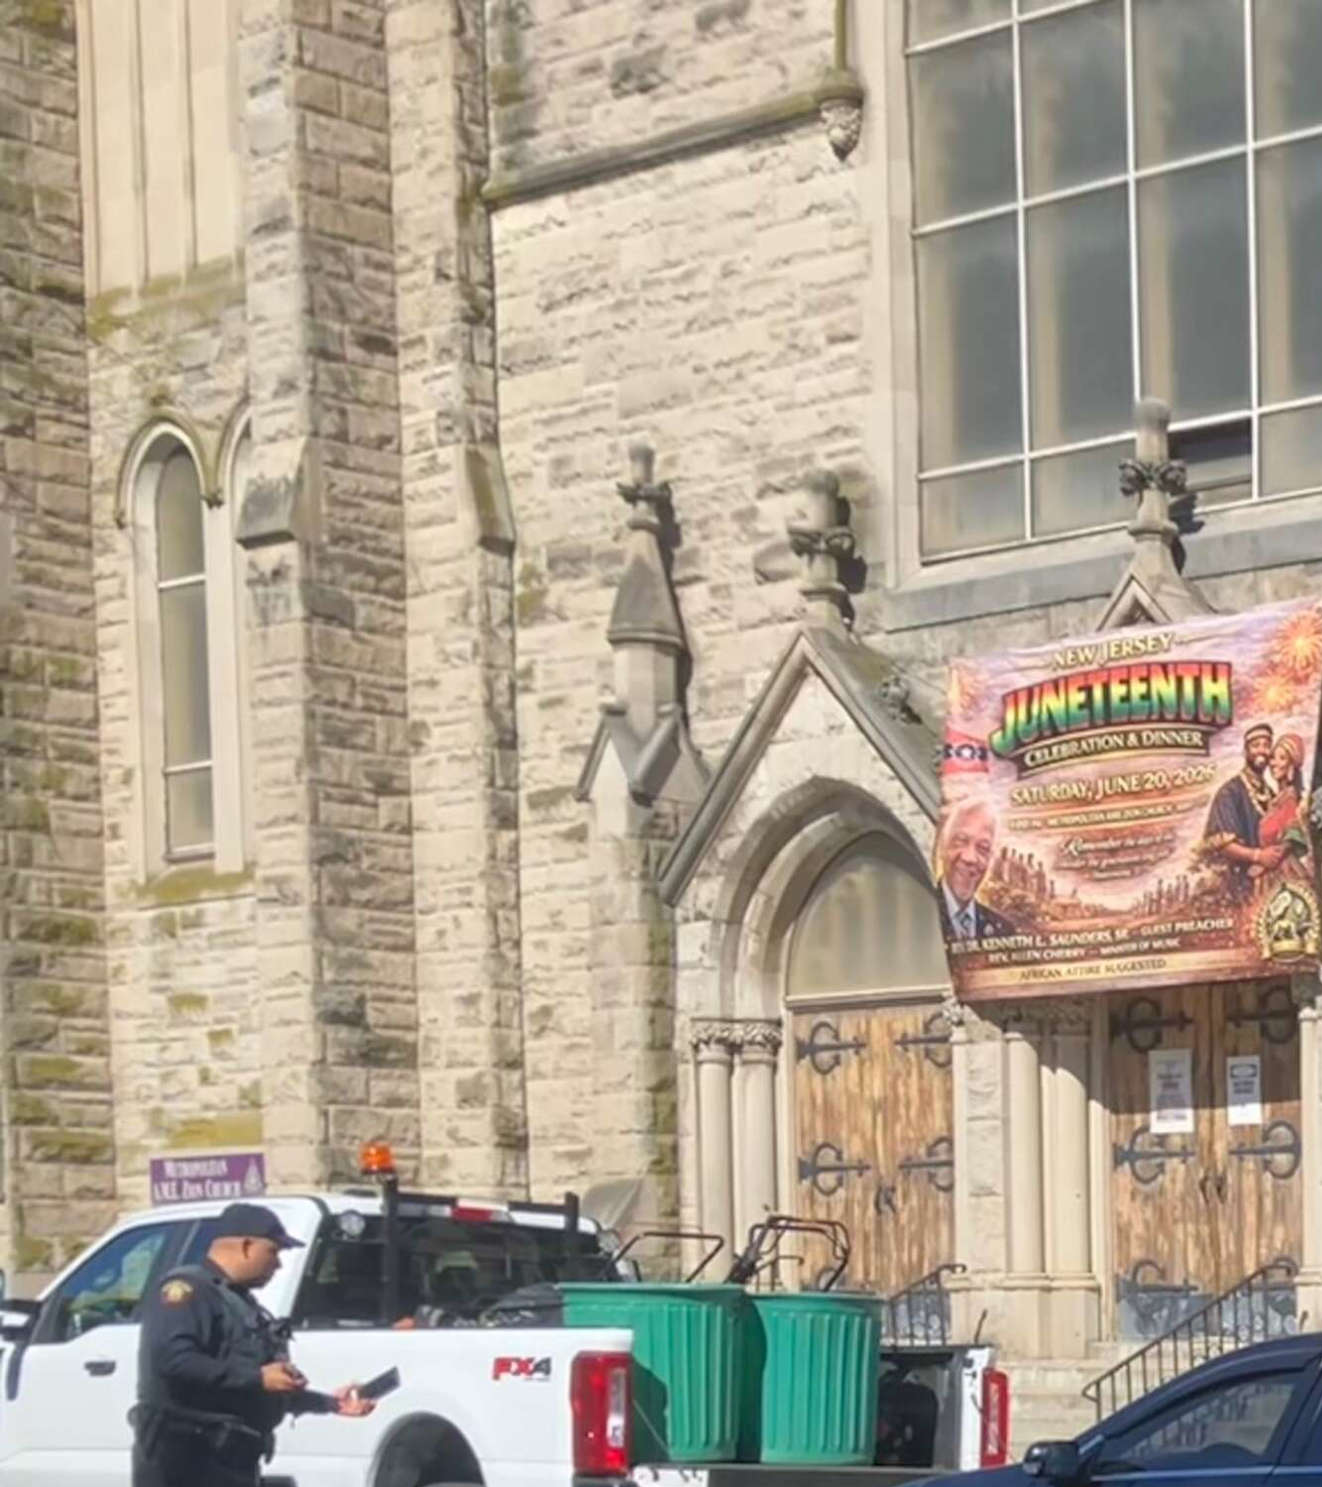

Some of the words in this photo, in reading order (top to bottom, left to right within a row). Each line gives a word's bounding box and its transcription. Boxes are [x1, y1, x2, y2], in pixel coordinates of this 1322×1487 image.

[1052, 647, 1095, 670] NEW
[1100, 634, 1175, 663] JERSEY
[990, 661, 1232, 752] JUNETEENTH
[1024, 732, 1124, 767] CELEBRATION
[1126, 732, 1138, 746] &
[1141, 729, 1205, 748] DINNER
[1011, 782, 1093, 806] SATURDAY,
[1096, 773, 1141, 799] JUNE
[1174, 917, 1233, 932] PREACHER
[1020, 967, 1062, 980] AFRICAN
[1104, 960, 1168, 974] SUGGESTED
[492, 1357, 552, 1381] FX4
